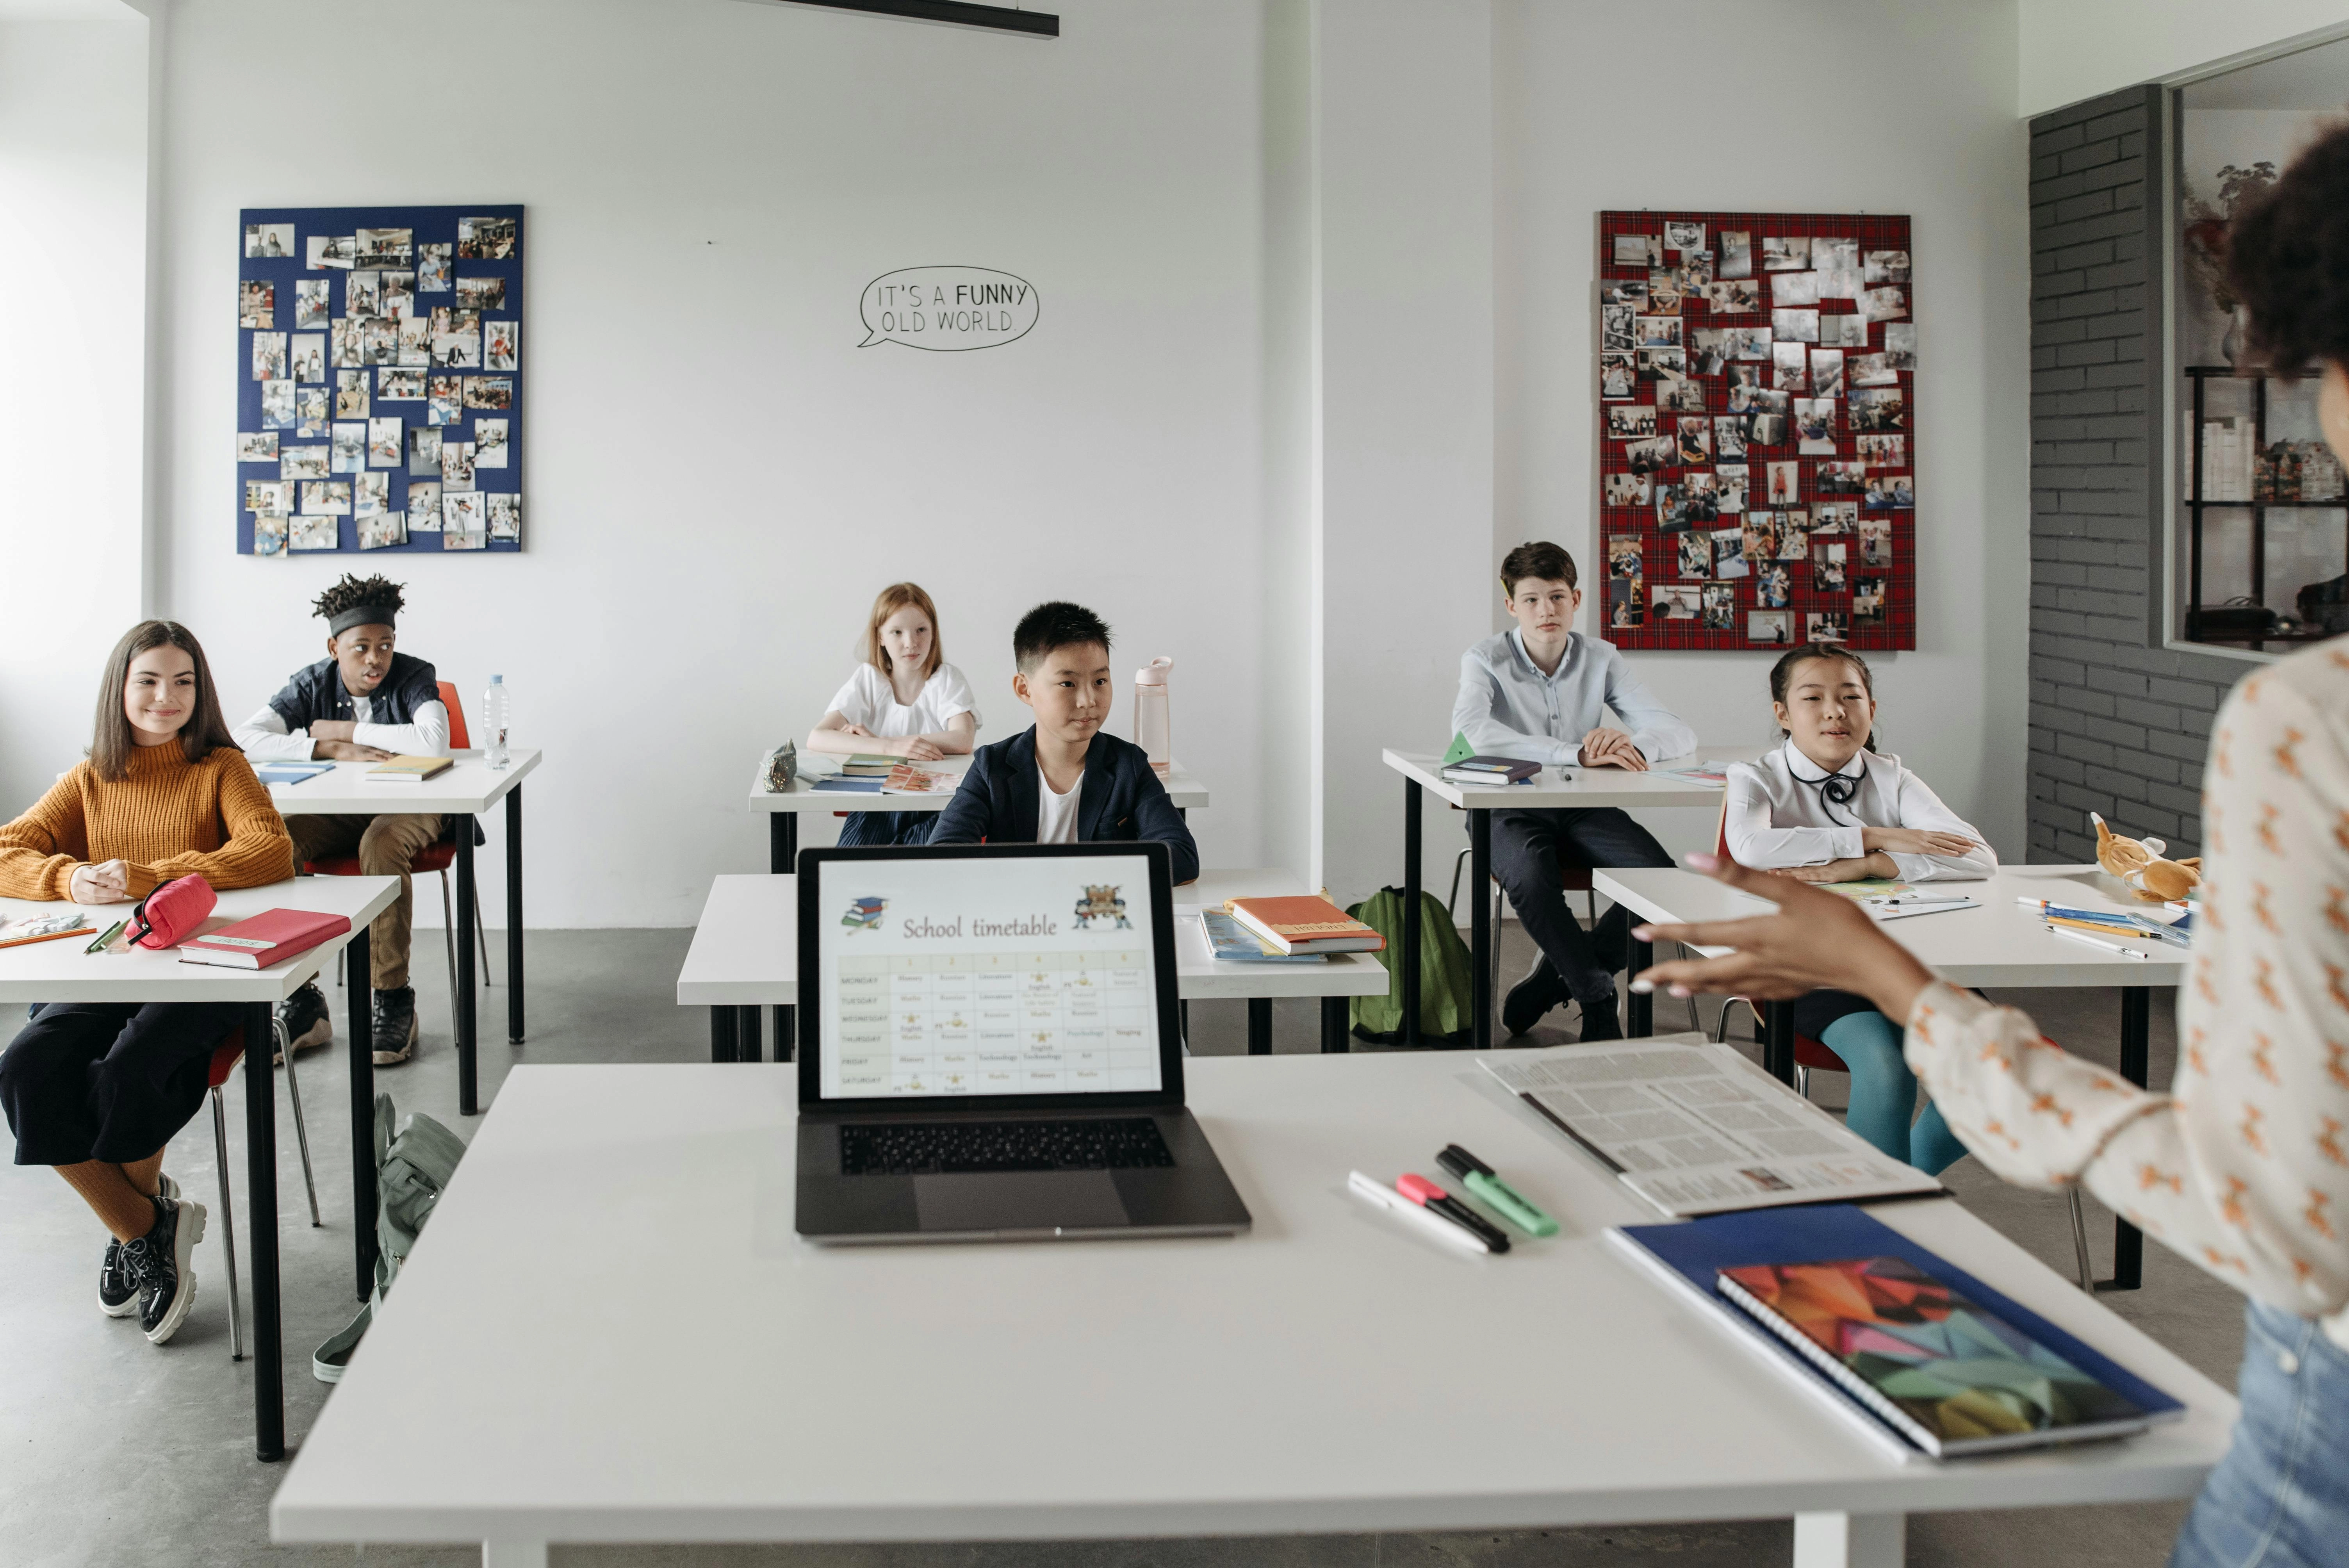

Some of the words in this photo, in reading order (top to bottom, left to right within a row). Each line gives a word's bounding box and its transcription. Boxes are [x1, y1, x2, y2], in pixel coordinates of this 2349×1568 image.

[879, 284, 922, 307] IT'S
[934, 286, 945, 305] A
[956, 284, 1028, 305] FUNNY
[882, 311, 925, 332] OLD
[904, 915, 962, 939] School
[973, 914, 1057, 937] timetable
[949, 957, 955, 966] 2
[841, 997, 877, 1005] TUESDAY
